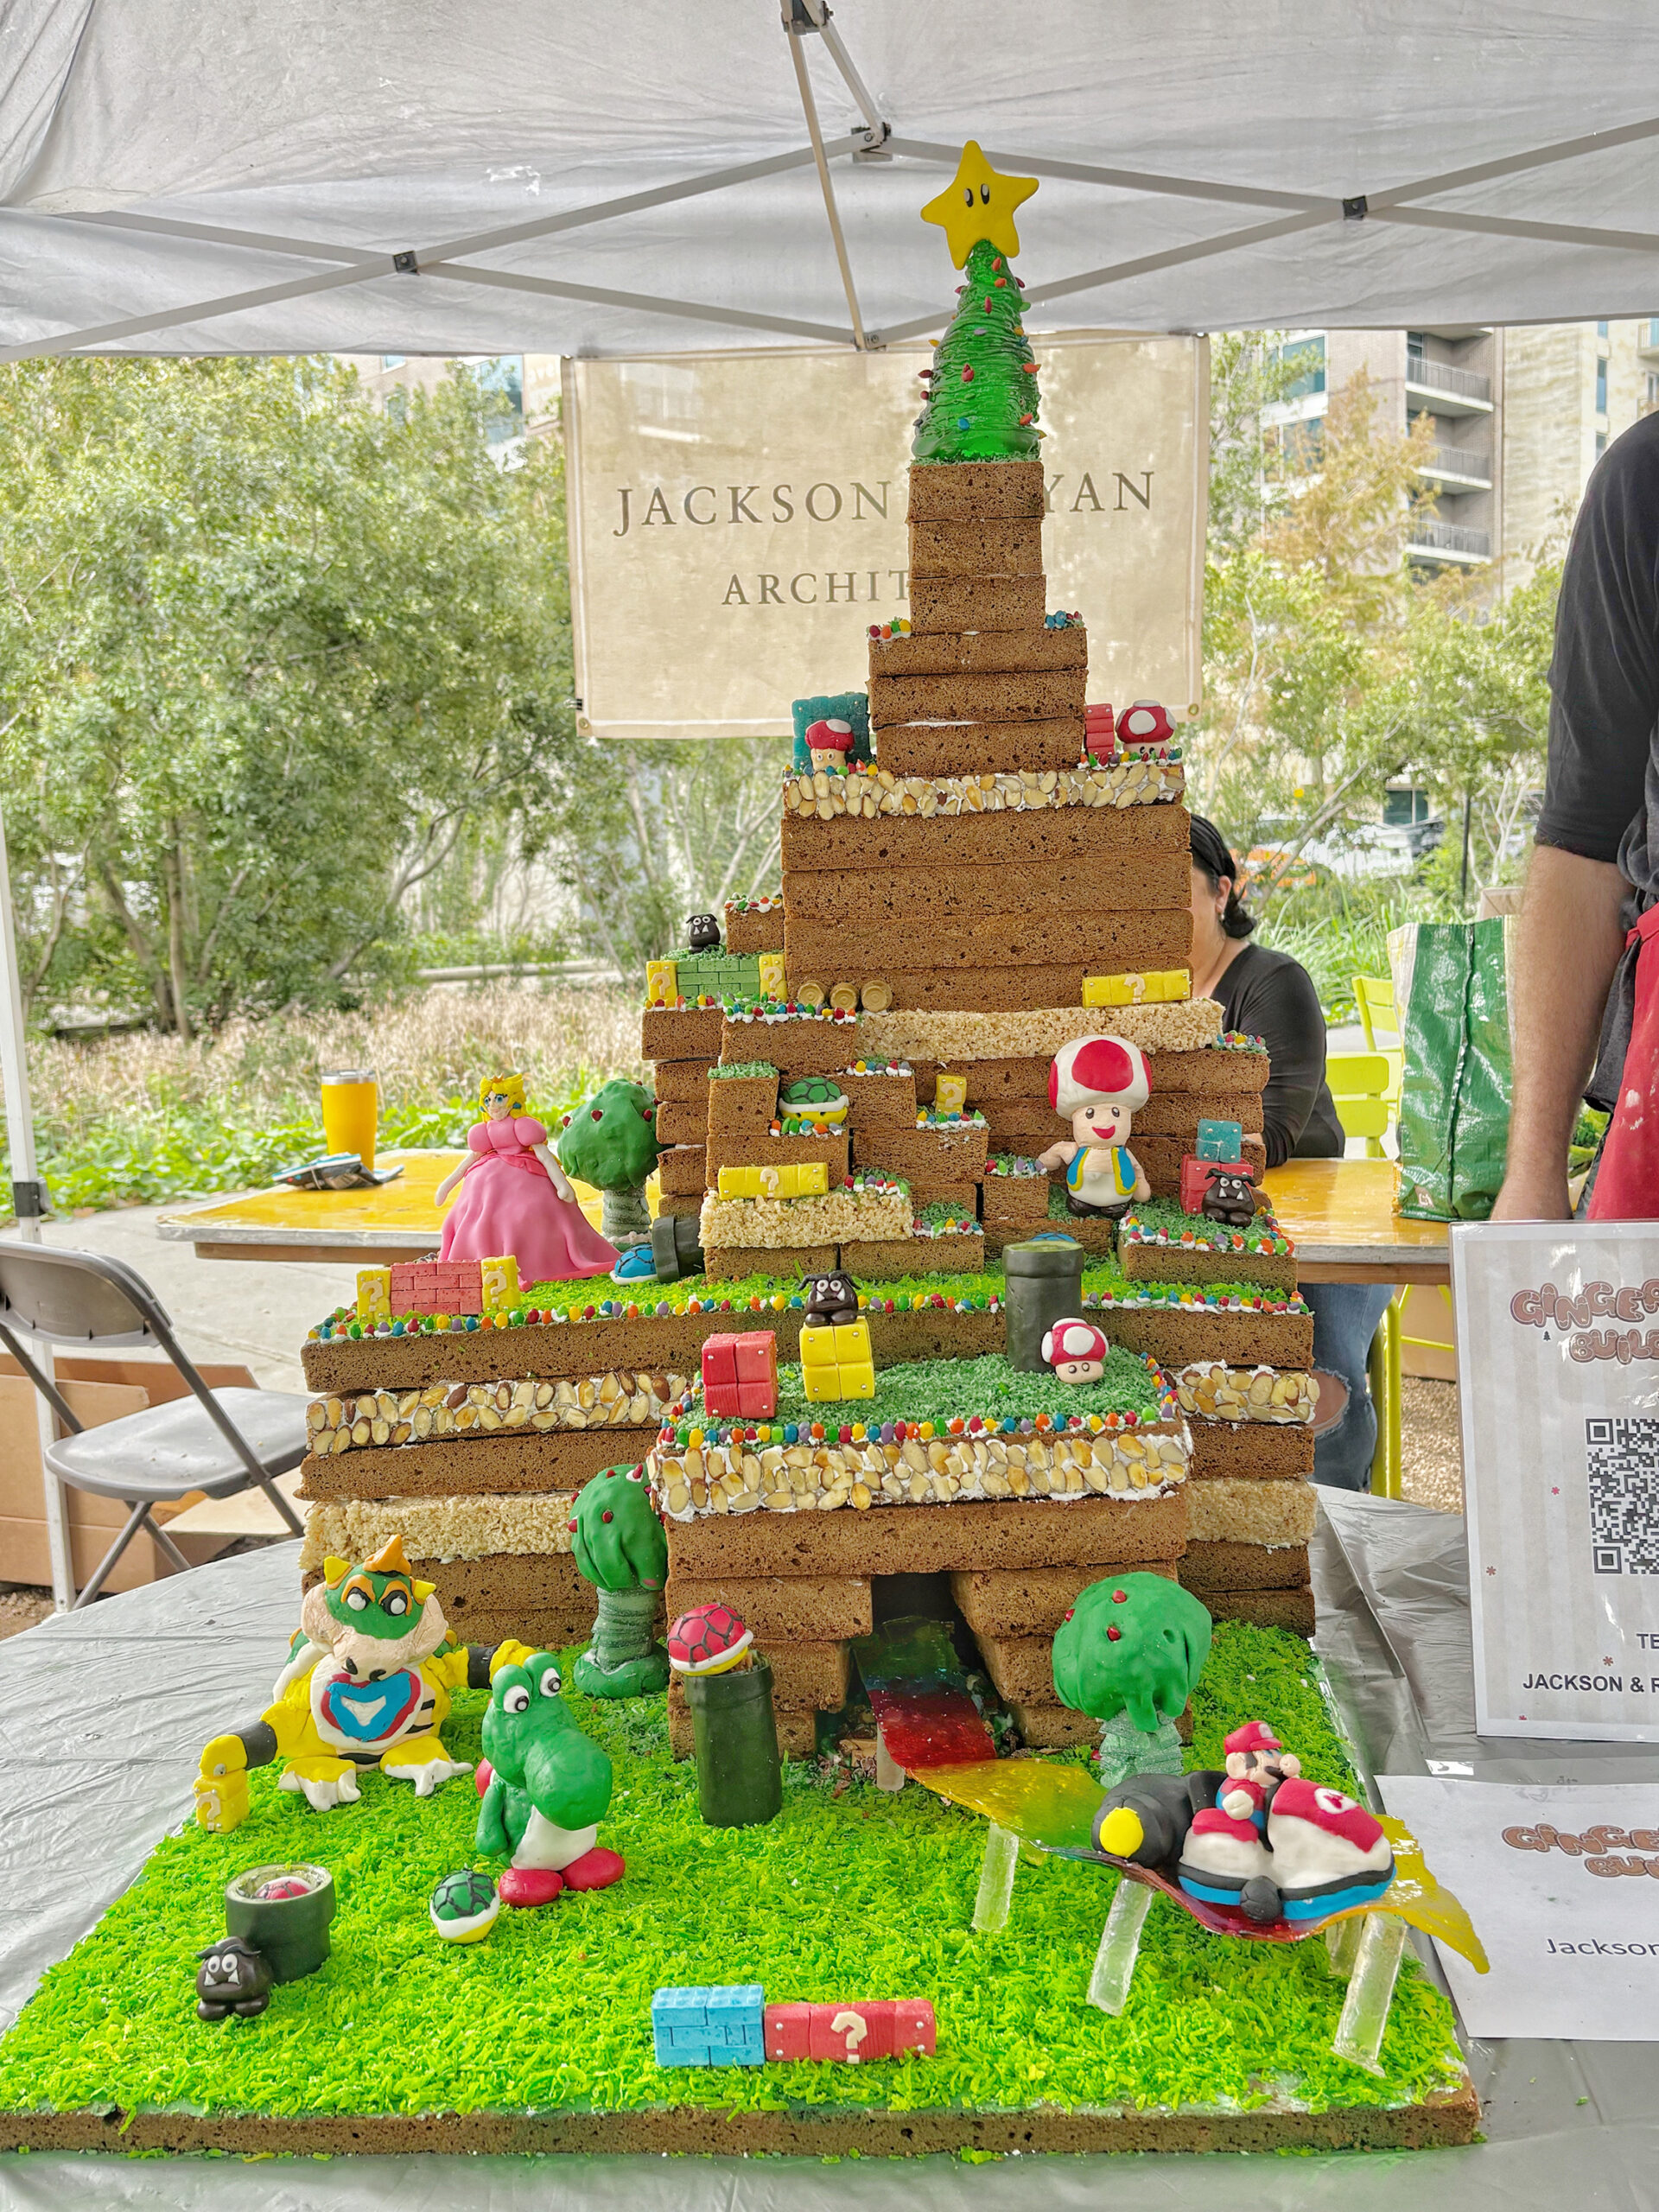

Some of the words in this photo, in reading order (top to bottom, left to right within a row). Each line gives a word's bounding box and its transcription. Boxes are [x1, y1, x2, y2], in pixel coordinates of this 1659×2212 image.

[613, 480, 892, 537] JACKSON
[1523, 1673, 1623, 1692] JACKSON
[1630, 1676, 1644, 1693] &
